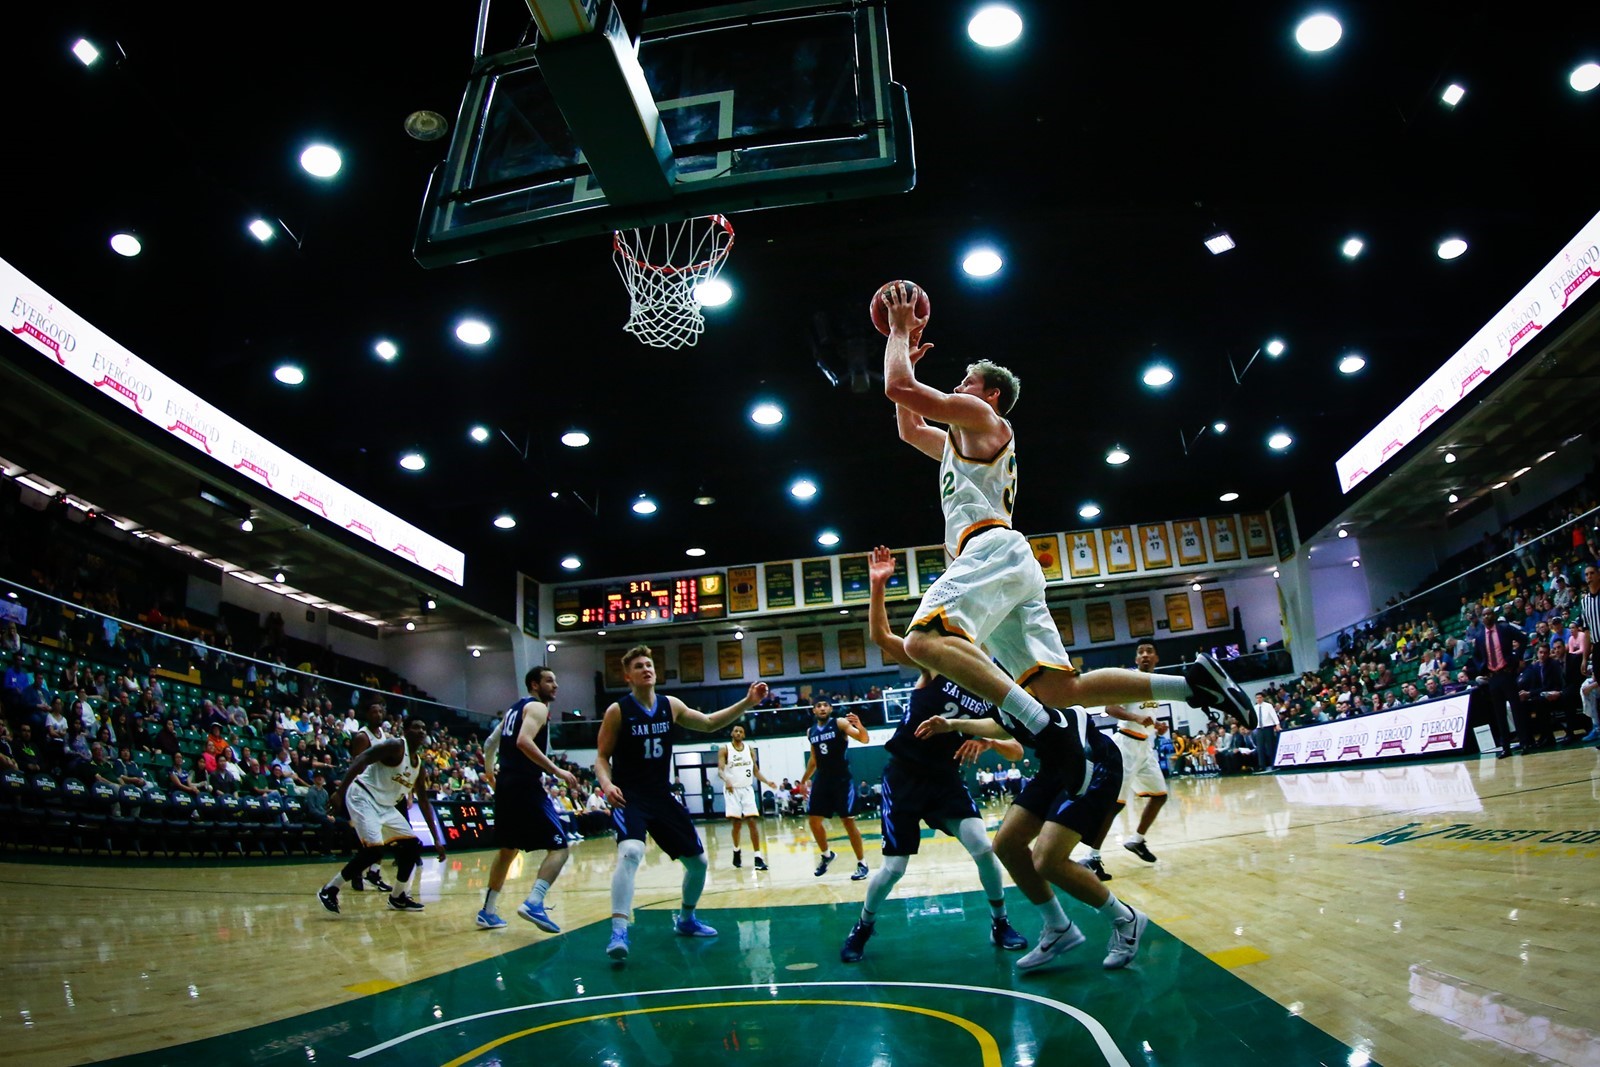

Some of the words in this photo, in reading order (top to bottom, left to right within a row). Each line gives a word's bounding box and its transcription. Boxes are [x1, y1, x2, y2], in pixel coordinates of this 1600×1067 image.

[1549, 245, 1599, 300] EVERGOOD
[11, 296, 76, 352] EVERGOOD
[1497, 301, 1542, 348] EVERGOOD
[24, 322, 39, 338] FINE
[40, 332, 59, 350] FOODS
[92, 352, 153, 402] EVERGOOD
[165, 399, 220, 442] EVERGOOD
[1219, 534, 1229, 543] 24
[1250, 529, 1262, 538] 32
[1150, 541, 1160, 550] 17
[1185, 538, 1196, 547] 20
[1080, 550, 1086, 558] 6
[630, 581, 650, 593] 3:17
[610, 601, 622, 611] 24
[502, 709, 518, 736] 10
[632, 724, 649, 736] SAN
[1420, 716, 1464, 738] EVERGOOD
[1375, 725, 1413, 745] EVERGOOD
[644, 738, 664, 759] 15
[745, 769, 752, 778] 3
[1443, 829, 1553, 841] WEST
